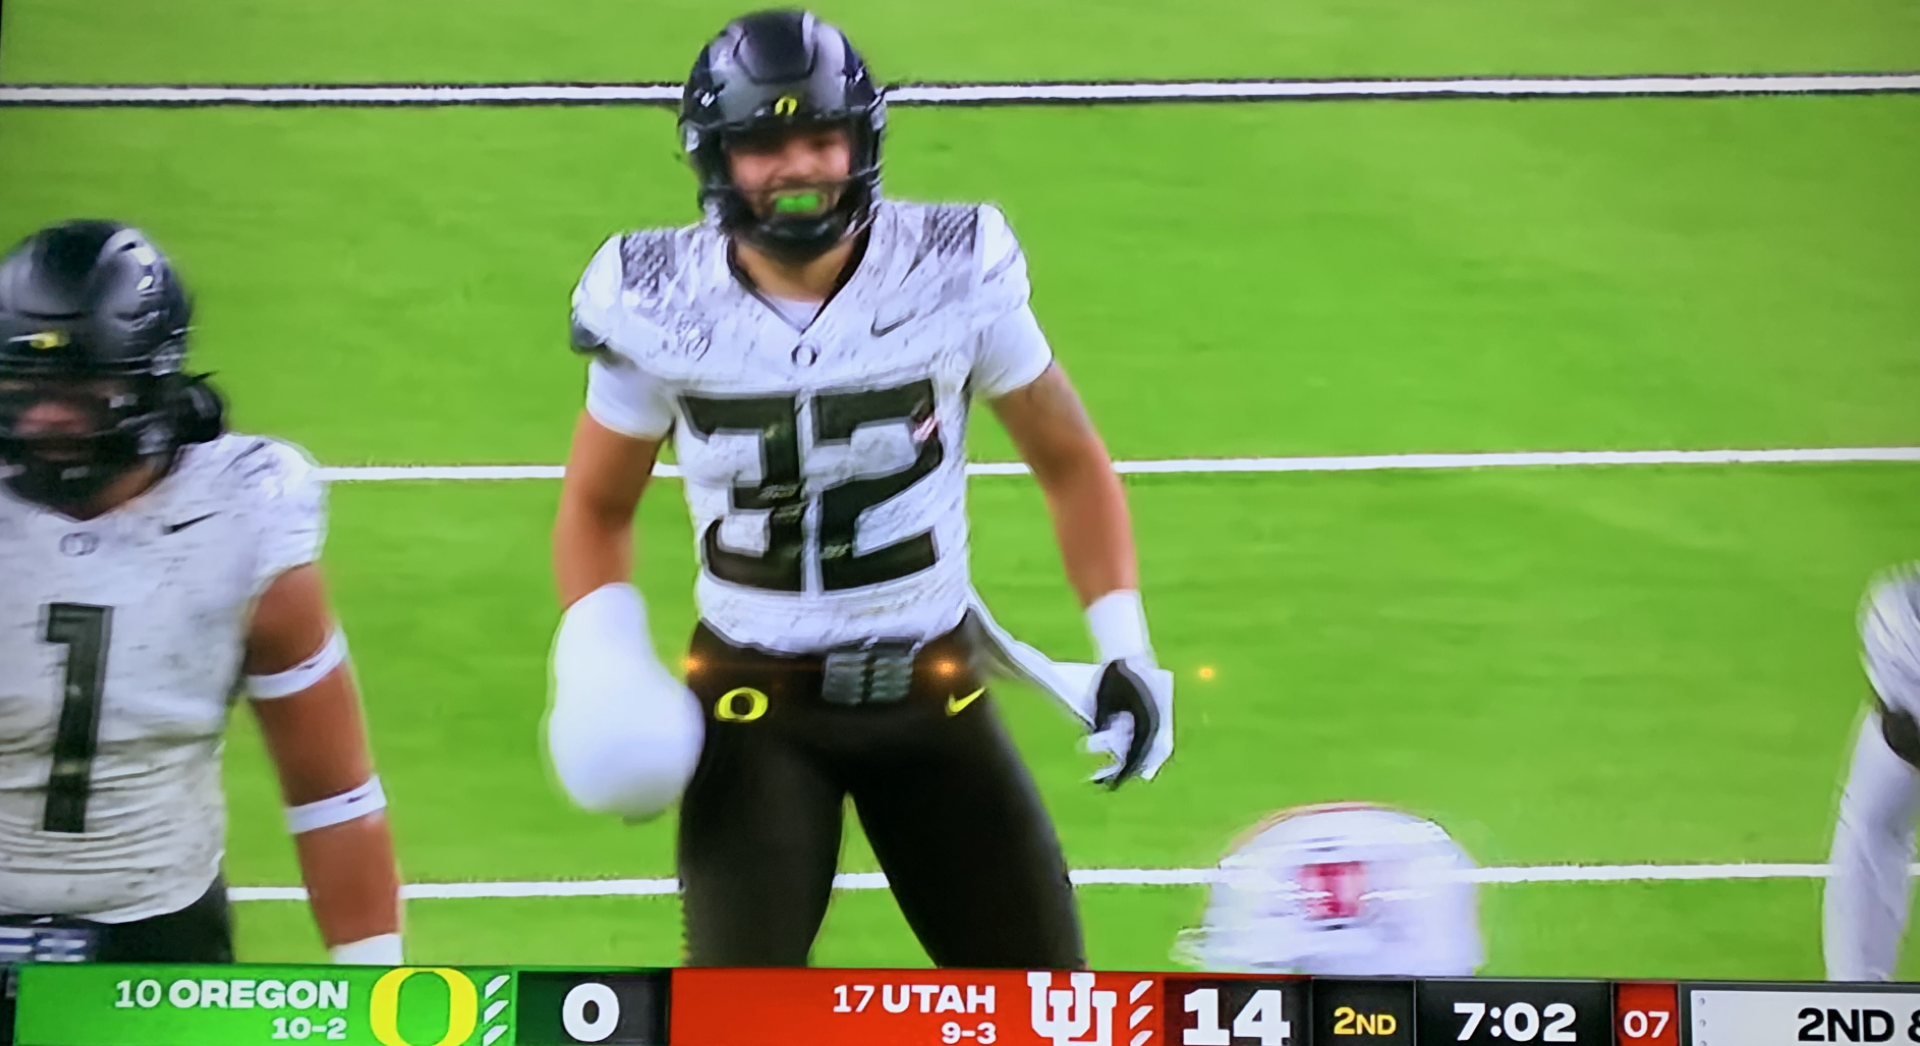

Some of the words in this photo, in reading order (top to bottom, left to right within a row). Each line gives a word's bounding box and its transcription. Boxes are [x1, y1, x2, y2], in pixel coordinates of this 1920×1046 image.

[677, 377, 945, 596] 32
[40, 602, 113, 833] 1
[114, 980, 162, 1008] 10
[168, 980, 349, 1009] OREGON
[369, 967, 477, 1046] O
[832, 985, 874, 1013] 17
[881, 985, 996, 1014] UTAH
[271, 1017, 347, 1041] 10-2
[1182, 988, 1292, 1045] 14
[1333, 1007, 1397, 1035] 2ND
[1453, 1003, 1577, 1042] 7:02
[1623, 1010, 1670, 1039] 07
[1797, 1007, 1894, 1043] 2ND
[941, 1021, 996, 1045] 9-3
